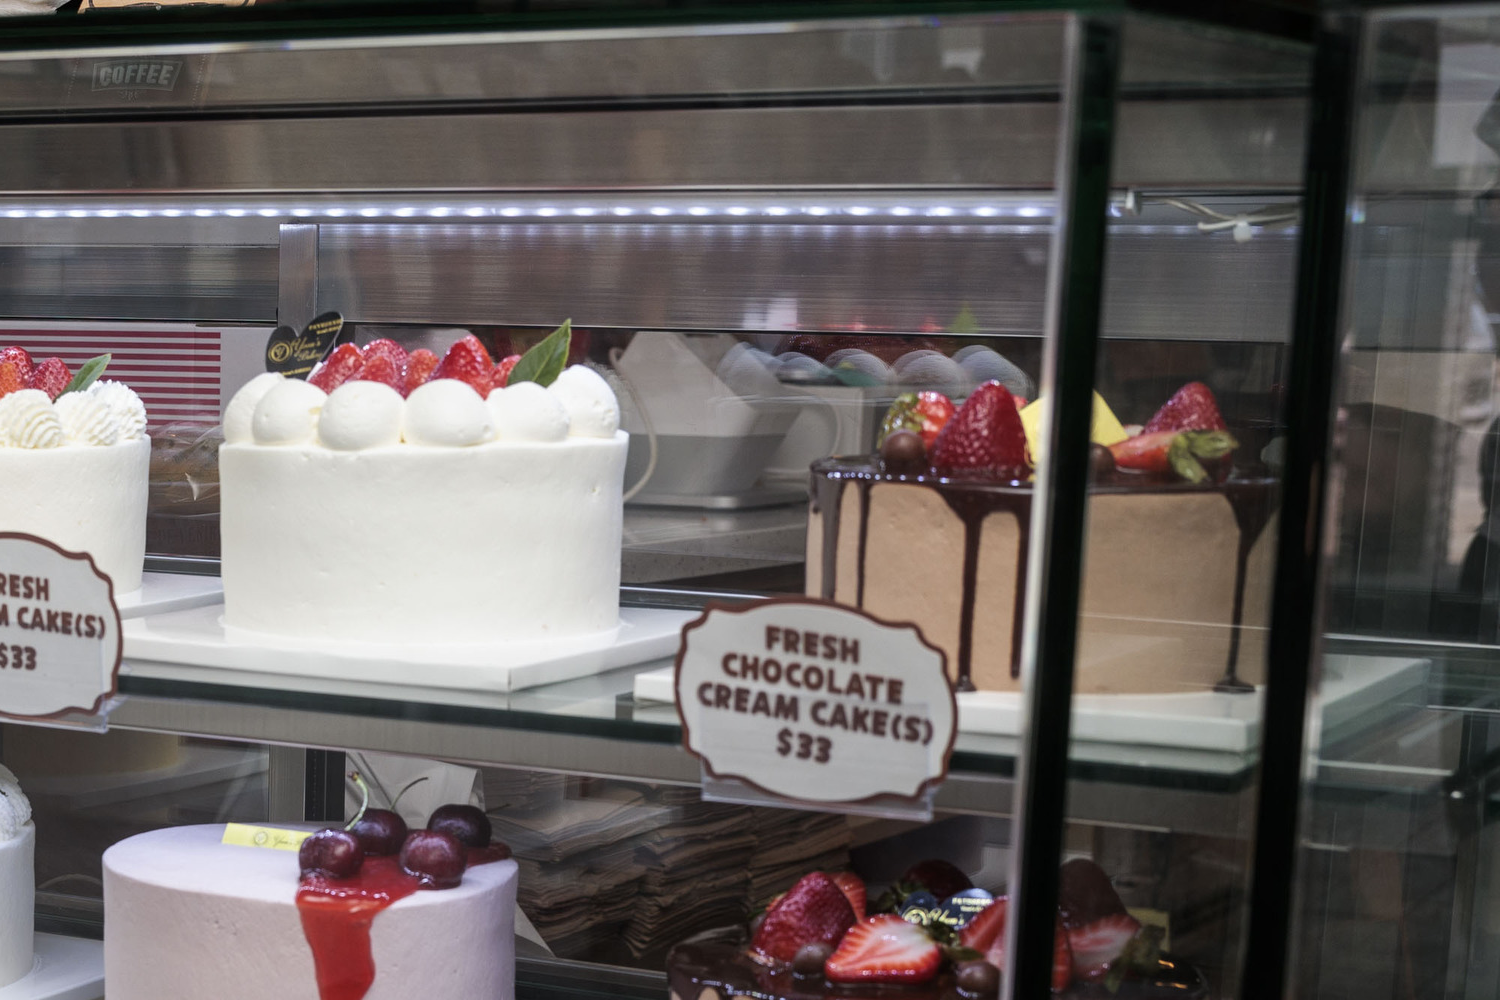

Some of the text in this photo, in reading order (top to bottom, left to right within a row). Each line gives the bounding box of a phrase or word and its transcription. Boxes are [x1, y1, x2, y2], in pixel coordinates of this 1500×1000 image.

[100, 65, 174, 87] COFFEE
[17, 607, 105, 639] CAKE(S)
[765, 625, 859, 664] FRESH
[722, 653, 904, 704] CHOCOLATE
[697, 682, 933, 746] CREAM CAKE(S)
[776, 727, 832, 764] $33
